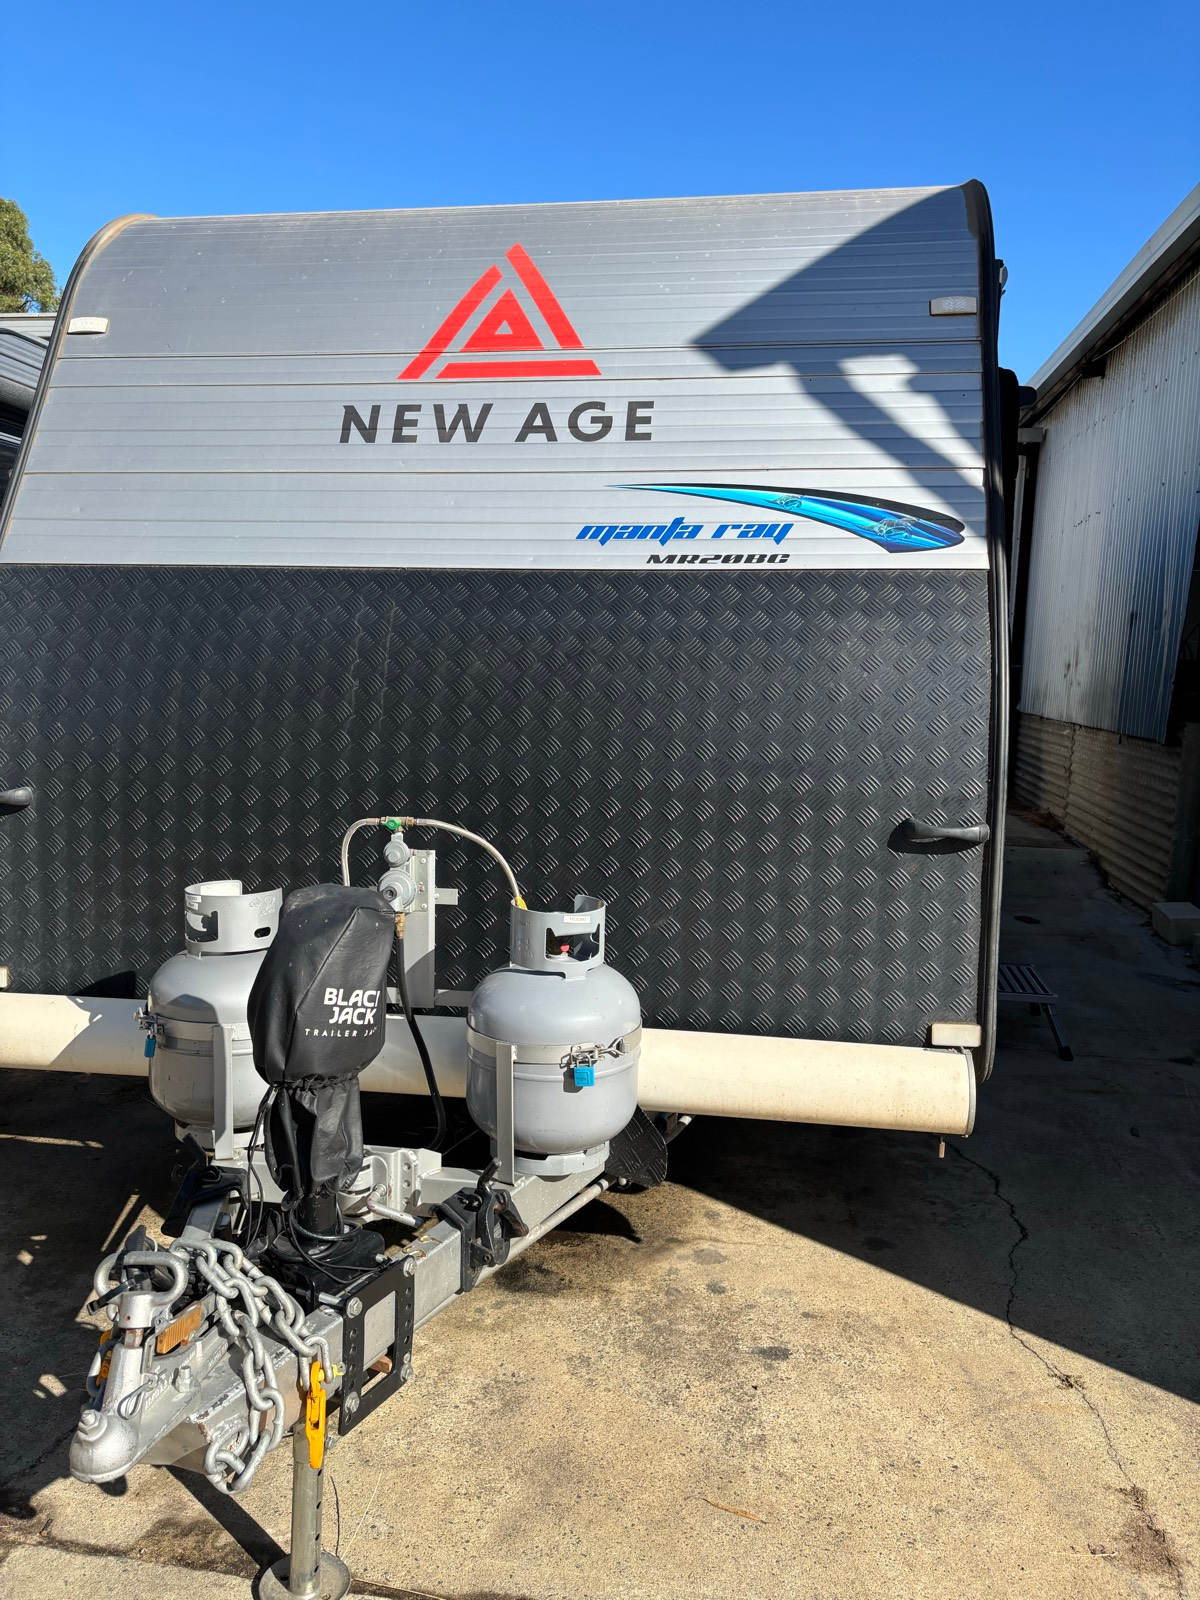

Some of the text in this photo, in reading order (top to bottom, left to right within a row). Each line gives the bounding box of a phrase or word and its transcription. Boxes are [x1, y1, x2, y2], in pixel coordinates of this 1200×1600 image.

[339, 401, 655, 443] NEW AGE
[575, 517, 794, 546] manta ray
[646, 554, 791, 564] MR20BC
[328, 1006, 377, 1025] JACK
[304, 1028, 358, 1037] TRAILER
